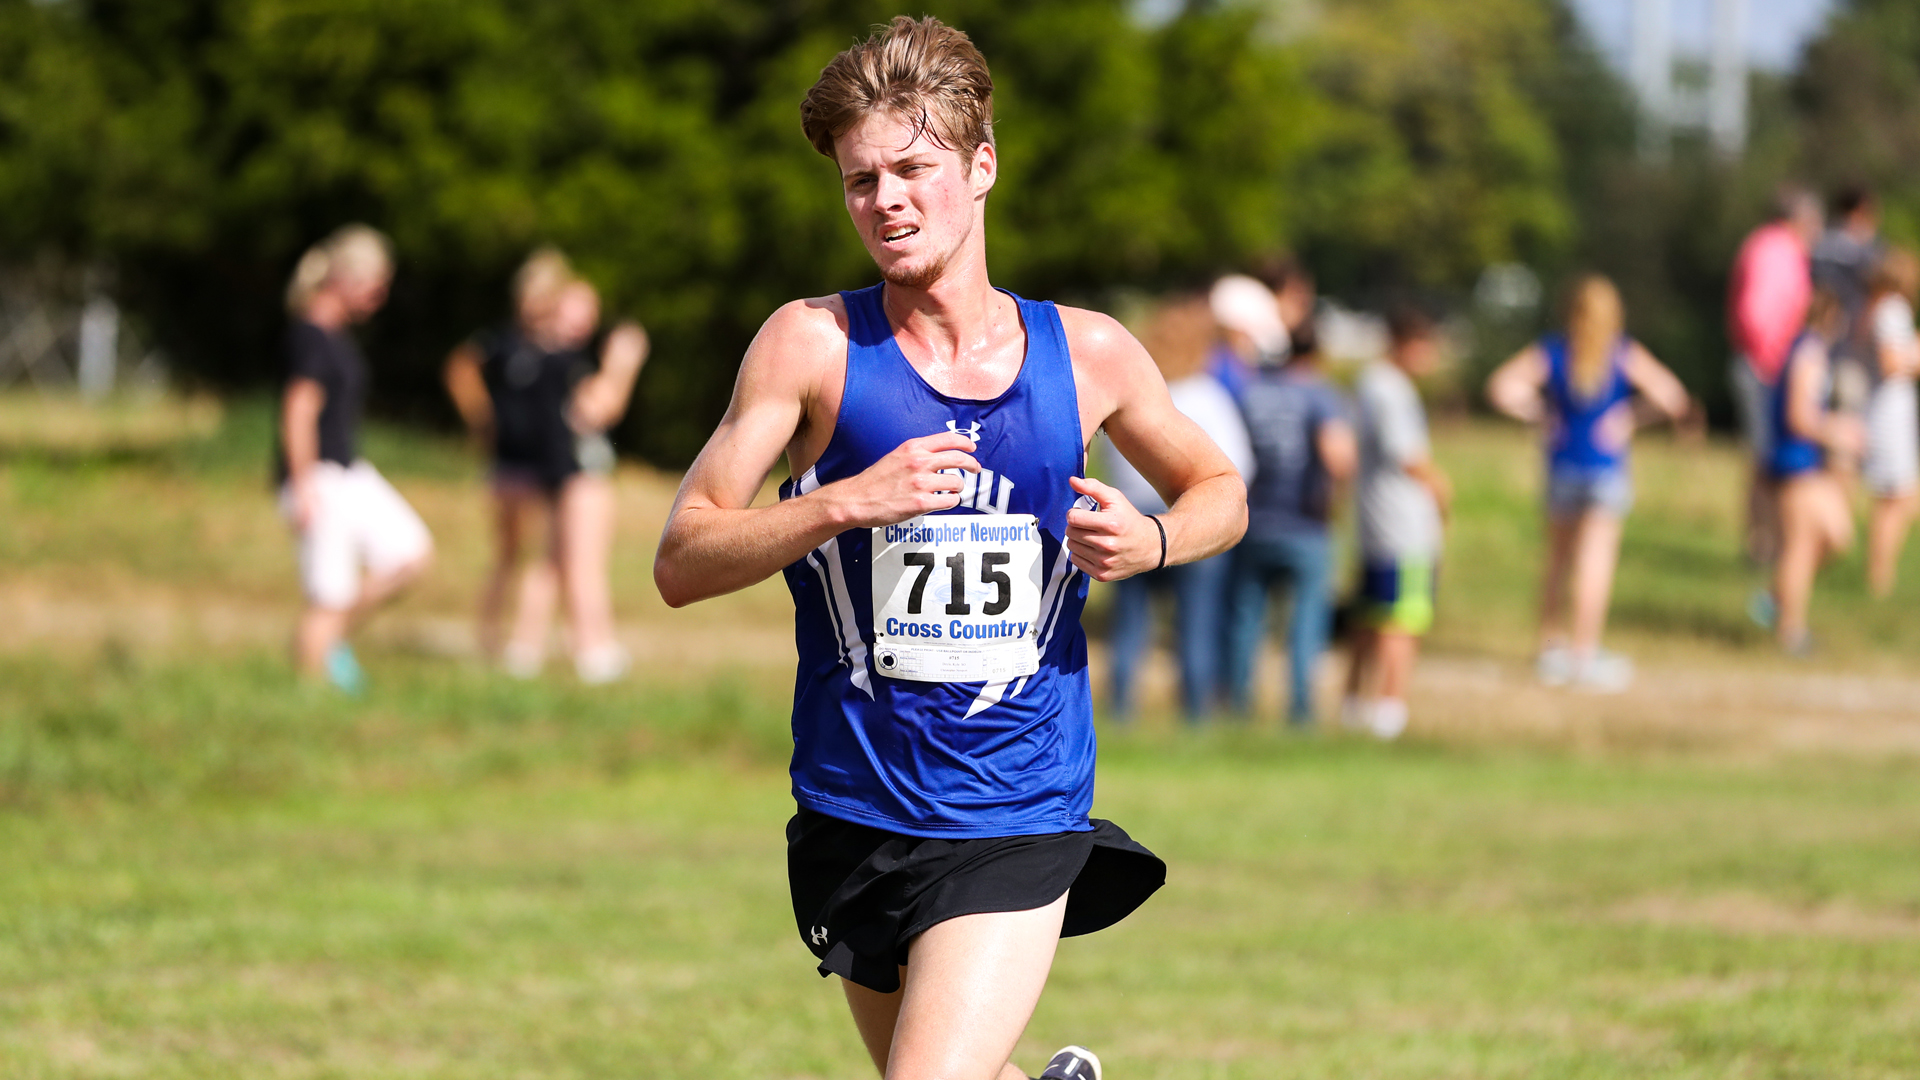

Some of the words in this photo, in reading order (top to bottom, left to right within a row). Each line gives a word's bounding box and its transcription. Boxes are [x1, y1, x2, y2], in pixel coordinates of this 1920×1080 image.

[934, 467, 1015, 514] NU
[885, 522, 966, 547] Christopher
[970, 522, 1030, 546] Newport
[903, 552, 1011, 616] 715
[886, 617, 943, 639] Cross
[949, 619, 1029, 640] Country
